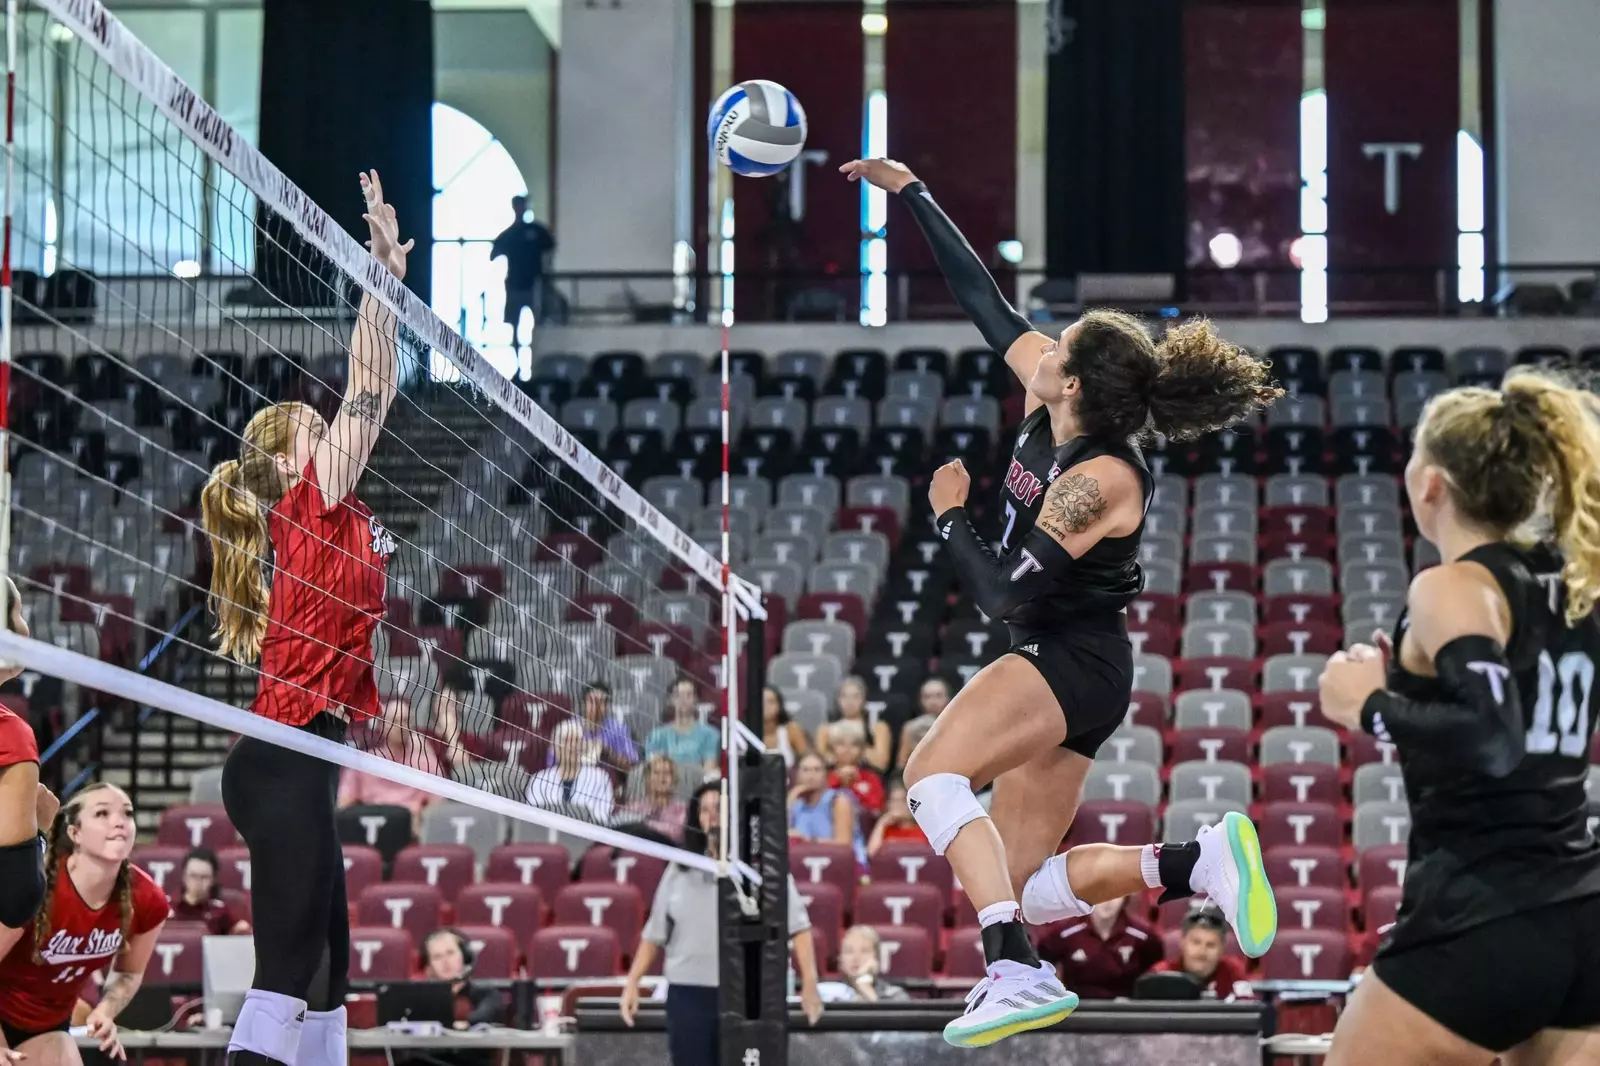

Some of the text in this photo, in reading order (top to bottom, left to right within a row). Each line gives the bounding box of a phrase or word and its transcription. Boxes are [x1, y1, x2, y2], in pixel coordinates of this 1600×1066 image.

[1361, 142, 1423, 215] T
[1005, 455, 1043, 508] TROY
[1003, 500, 1017, 550] 7
[1010, 547, 1044, 582] T
[794, 665, 814, 690] T
[875, 666, 897, 690] T
[1205, 667, 1229, 692] T
[1288, 667, 1312, 691] T
[1466, 661, 1509, 705] T
[1202, 702, 1225, 727] T
[1288, 702, 1312, 727] T
[1525, 649, 1595, 758] 10
[1112, 739, 1134, 761] T
[1199, 739, 1223, 761] T
[1288, 741, 1312, 763] T
[1108, 775, 1130, 800] T
[1200, 776, 1223, 803] T
[1290, 776, 1314, 802] T
[185, 818, 212, 847] T
[360, 816, 386, 844] T
[451, 817, 475, 843] T
[1101, 815, 1125, 841] T
[1289, 816, 1313, 843] T
[1382, 816, 1407, 844] T
[421, 857, 447, 886] T
[515, 857, 541, 886] T
[803, 857, 831, 884] T
[900, 857, 926, 884] T
[1290, 859, 1317, 886] T
[384, 899, 411, 929] T
[483, 896, 512, 928] T
[583, 897, 612, 928] T
[883, 897, 912, 925] T
[1294, 901, 1320, 929] T
[156, 944, 183, 975] T
[354, 941, 382, 972] T
[558, 939, 589, 971] T
[1293, 945, 1321, 976] T
